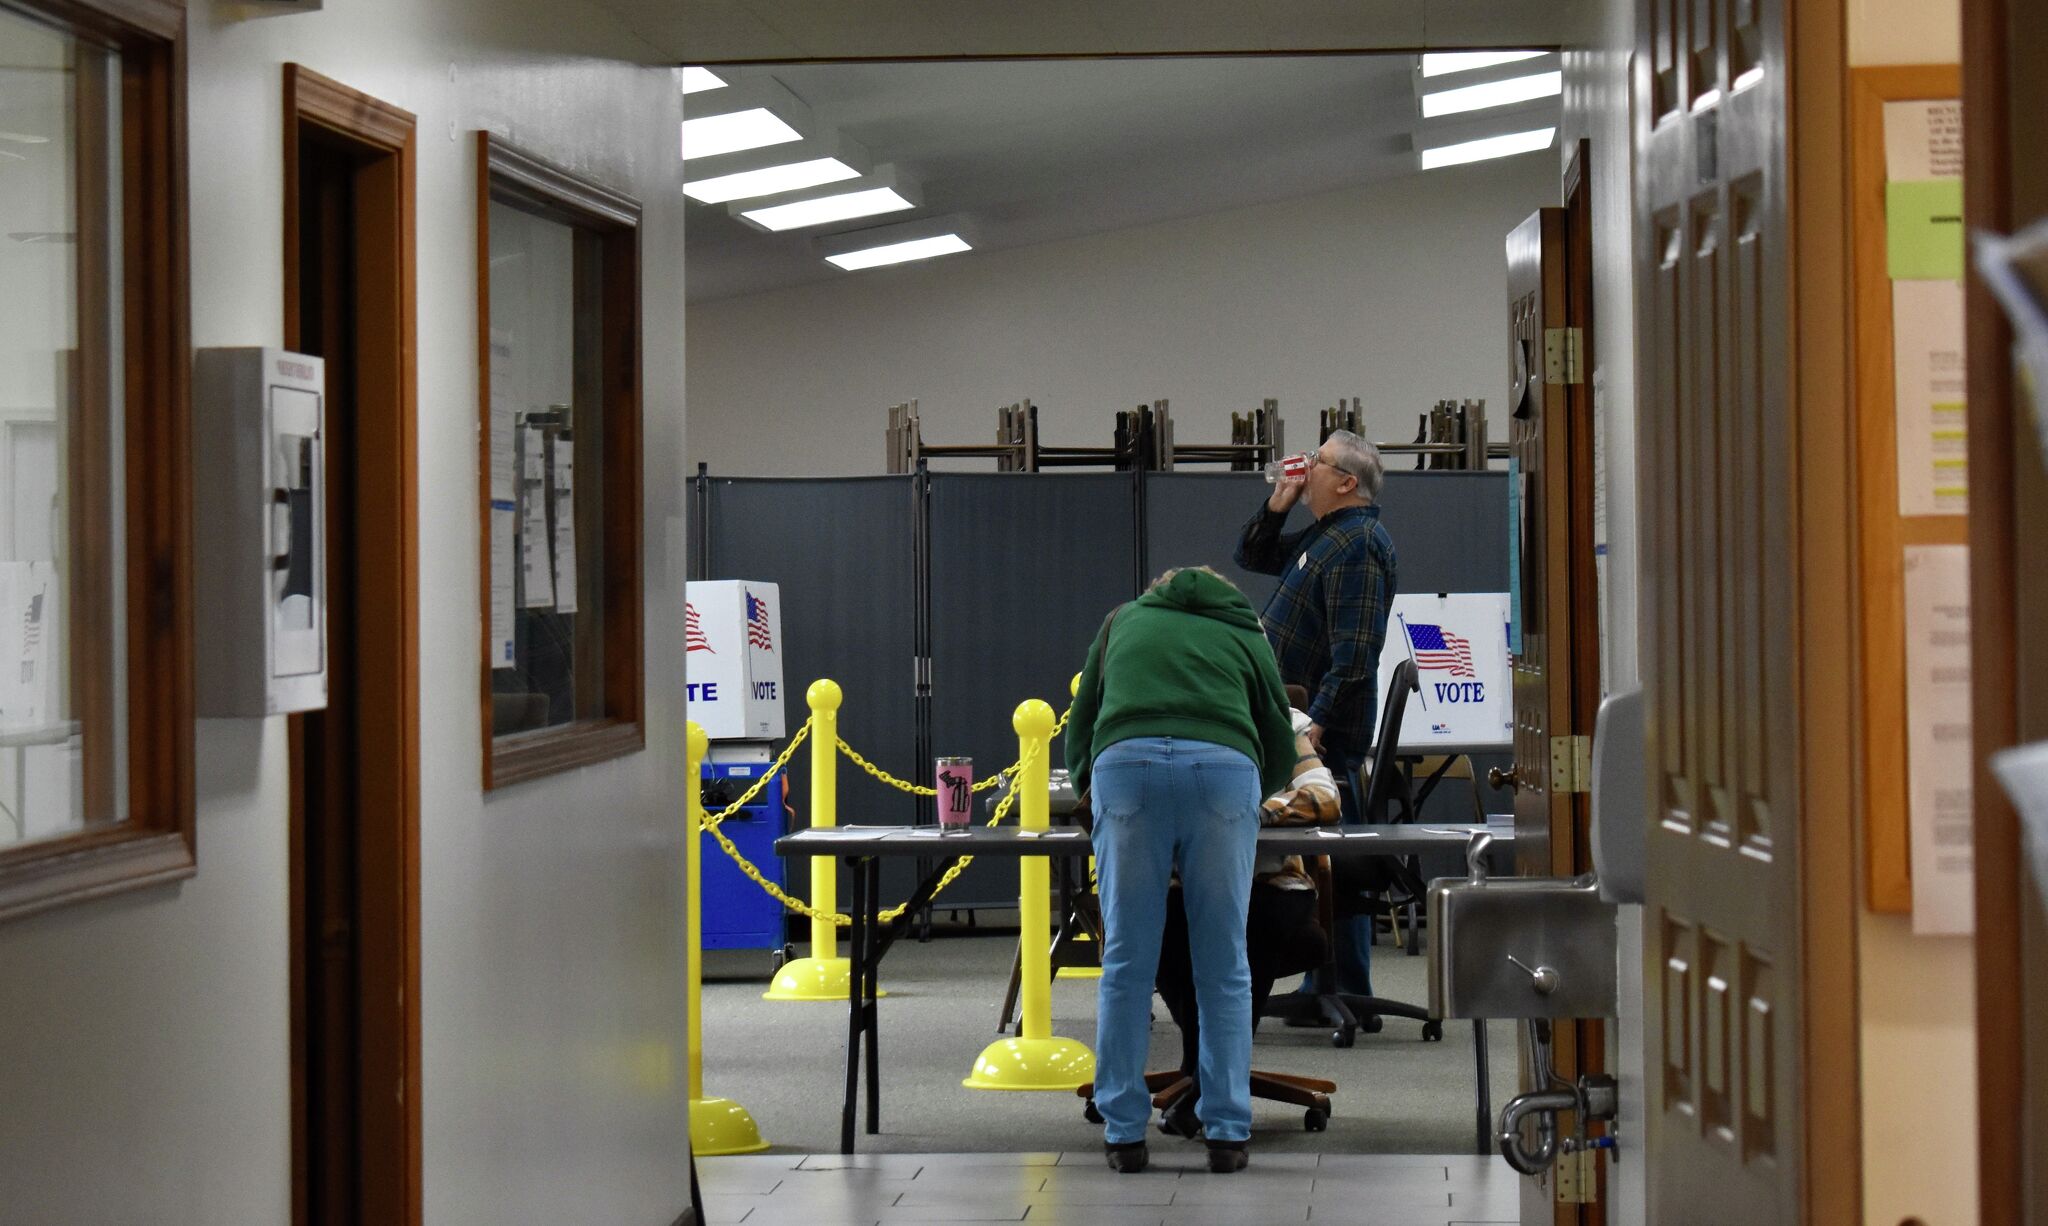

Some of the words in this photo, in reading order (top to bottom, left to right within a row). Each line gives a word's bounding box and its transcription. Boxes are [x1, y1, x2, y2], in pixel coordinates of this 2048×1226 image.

[686, 683, 718, 701] TE
[753, 681, 776, 700] VOTE
[1434, 682, 1485, 703] VOTE
